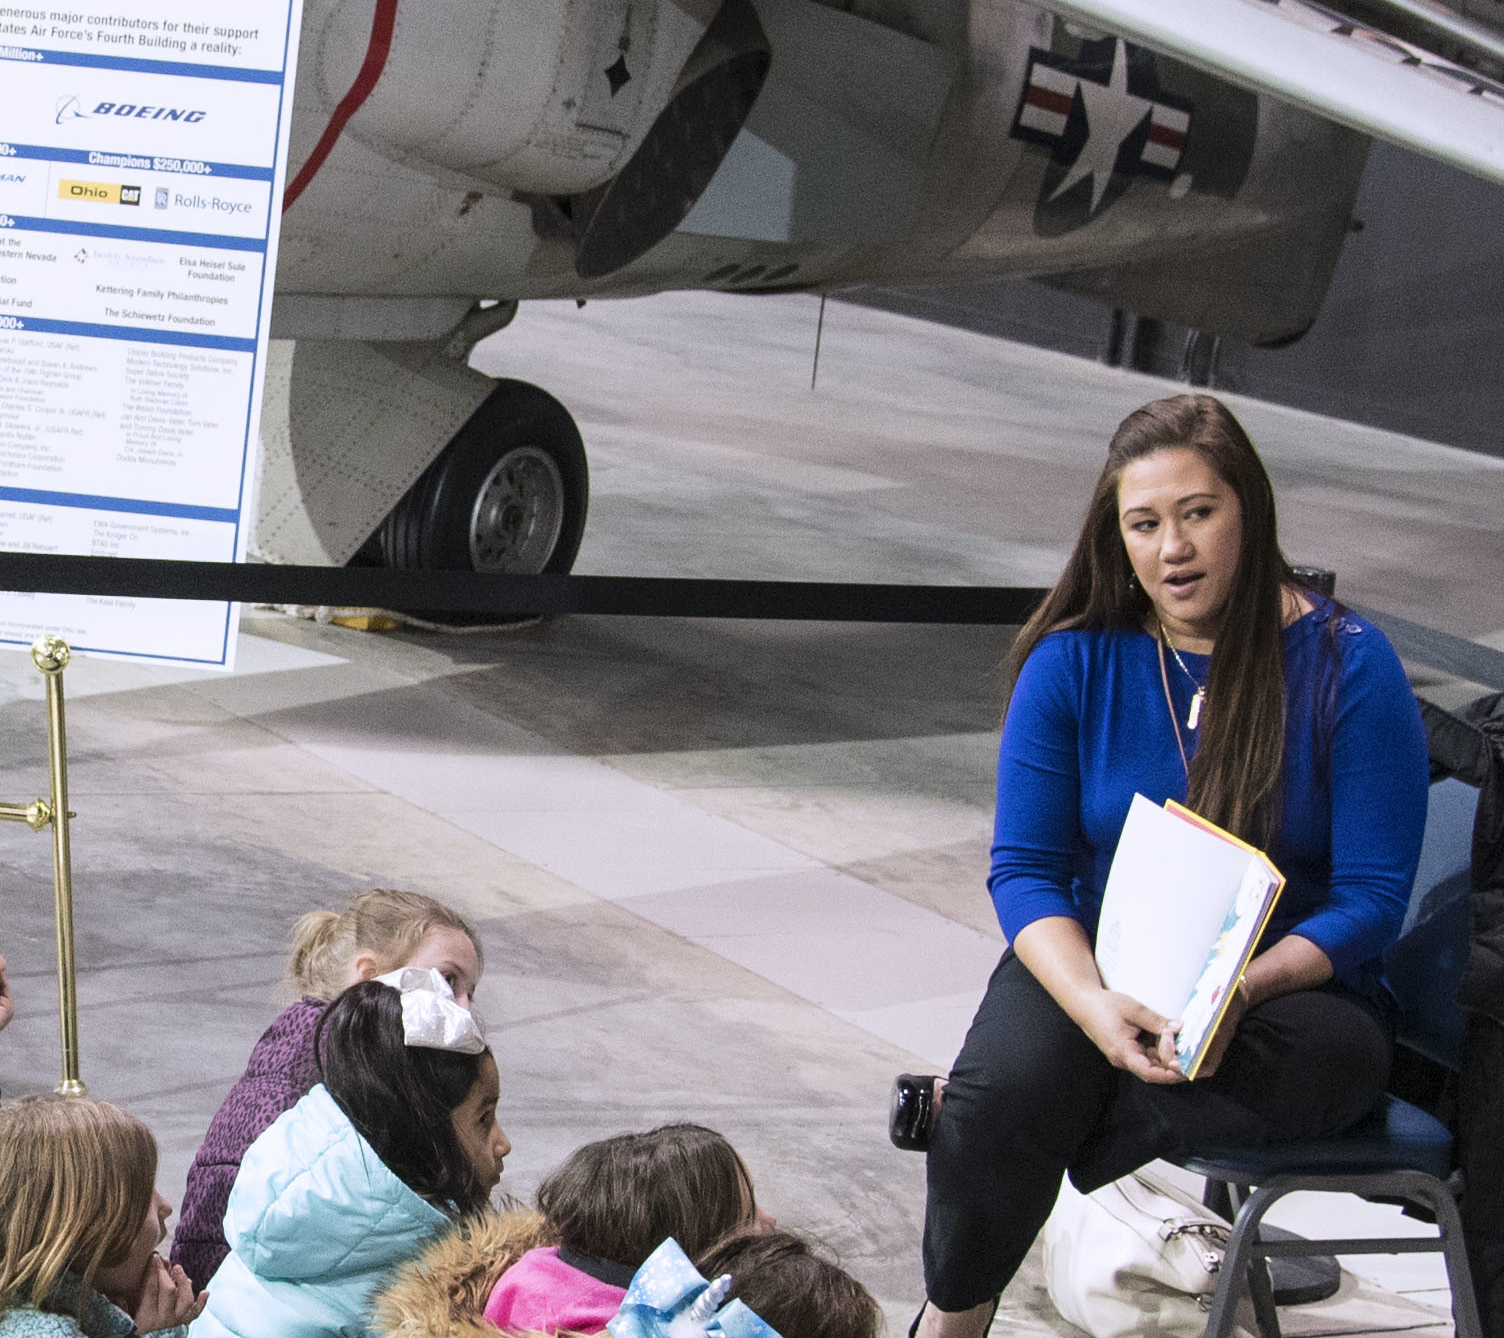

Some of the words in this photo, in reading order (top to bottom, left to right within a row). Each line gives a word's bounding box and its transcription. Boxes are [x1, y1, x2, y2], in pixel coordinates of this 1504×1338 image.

[49, 11, 84, 26] major
[86, 13, 159, 31] contributors
[161, 19, 179, 32] for
[182, 21, 210, 35] their
[212, 25, 259, 42] support
[29, 24, 48, 37] Air
[50, 25, 94, 41] Force's
[96, 30, 135, 45] Fourth
[137, 33, 187, 52] Building
[189, 41, 198, 51] a
[92, 101, 206, 124] BOEING
[87, 152, 151, 171] Champions
[152, 158, 212, 176] $250,000+
[69, 184, 108, 198] Ohio
[173, 193, 252, 217] Rolls-Royce
[7, 237, 22, 247] the
[24, 250, 57, 262] Nevada
[186, 268, 236, 283] Foundation
[10, 297, 33, 308] Fund
[95, 284, 134, 298] Kettering
[135, 287, 165, 300] Family
[166, 290, 229, 306] Philanthropies
[103, 306, 120, 317] The
[167, 313, 216, 327] Foundation
